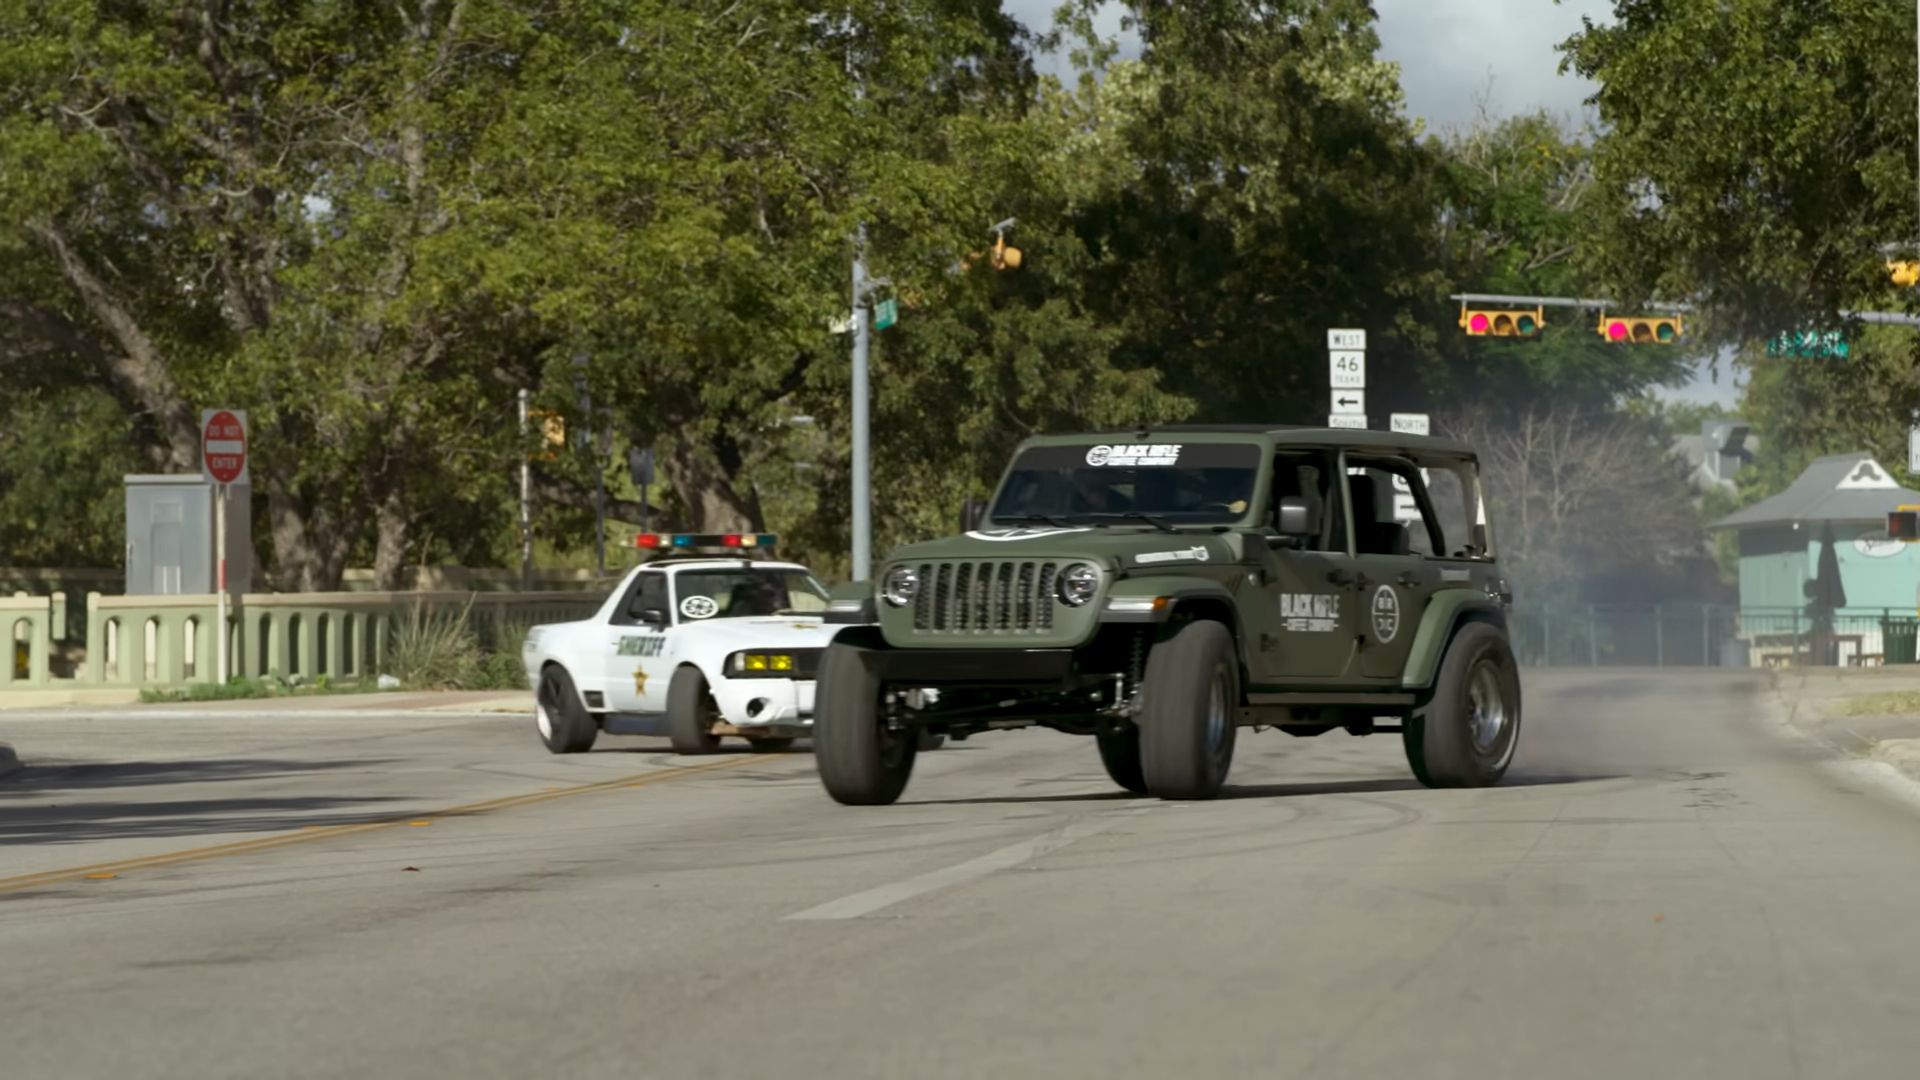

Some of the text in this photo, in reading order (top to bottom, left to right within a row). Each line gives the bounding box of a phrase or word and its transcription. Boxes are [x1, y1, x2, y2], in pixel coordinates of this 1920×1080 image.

[1336, 356, 1359, 372] 46
[209, 425, 220, 437] DO
[213, 457, 237, 469] ENTER
[1281, 594, 1339, 618] BLACK RIFLE
